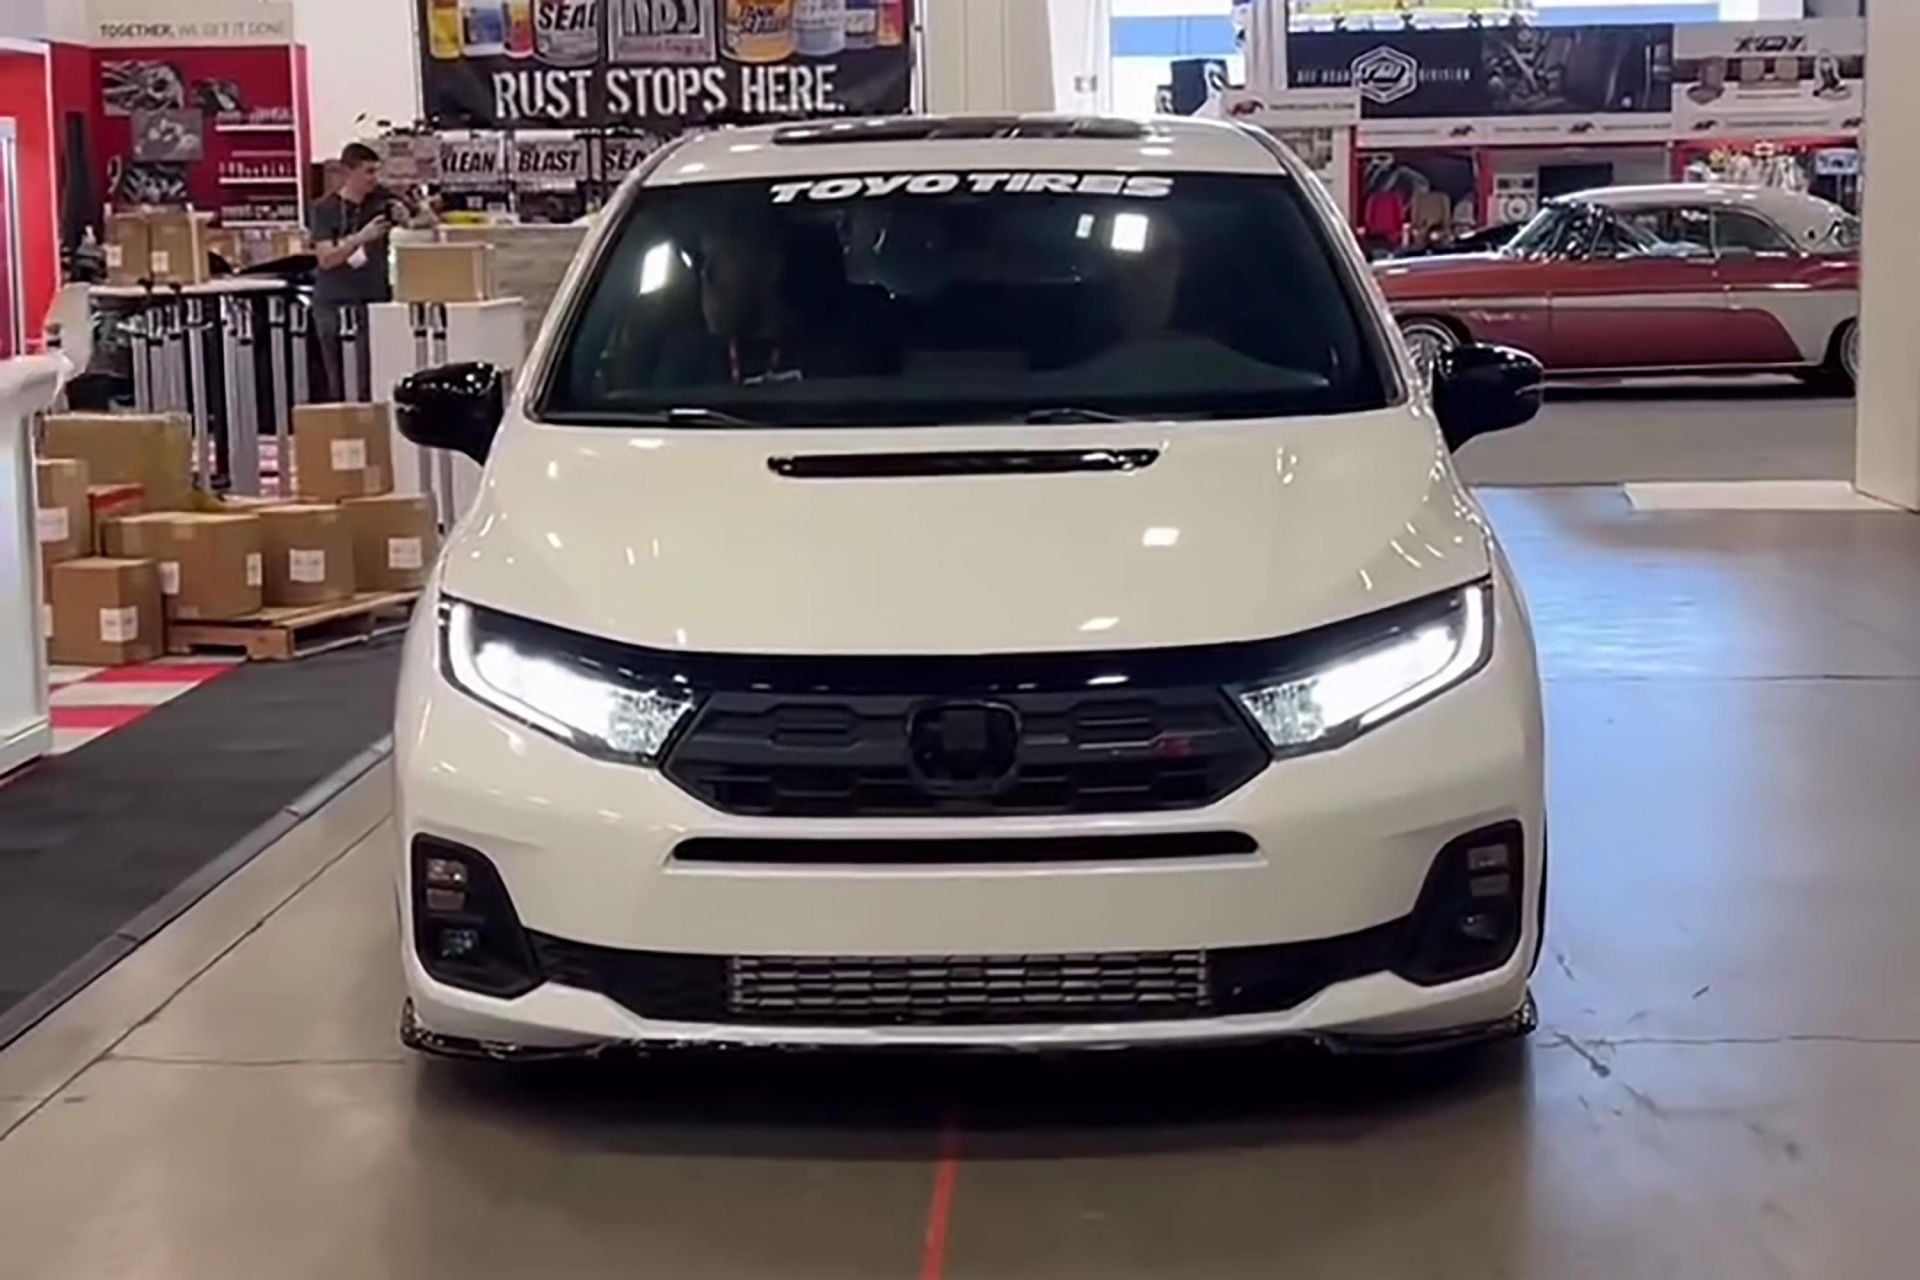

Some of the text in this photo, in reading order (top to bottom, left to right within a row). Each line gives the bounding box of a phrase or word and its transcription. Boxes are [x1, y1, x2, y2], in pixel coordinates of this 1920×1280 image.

[100, 23, 176, 38] TOGETHER,
[493, 64, 846, 119] RUST STOPS HERE.
[518, 150, 581, 173] BLAST
[769, 171, 1174, 204] TOYO TIRES
